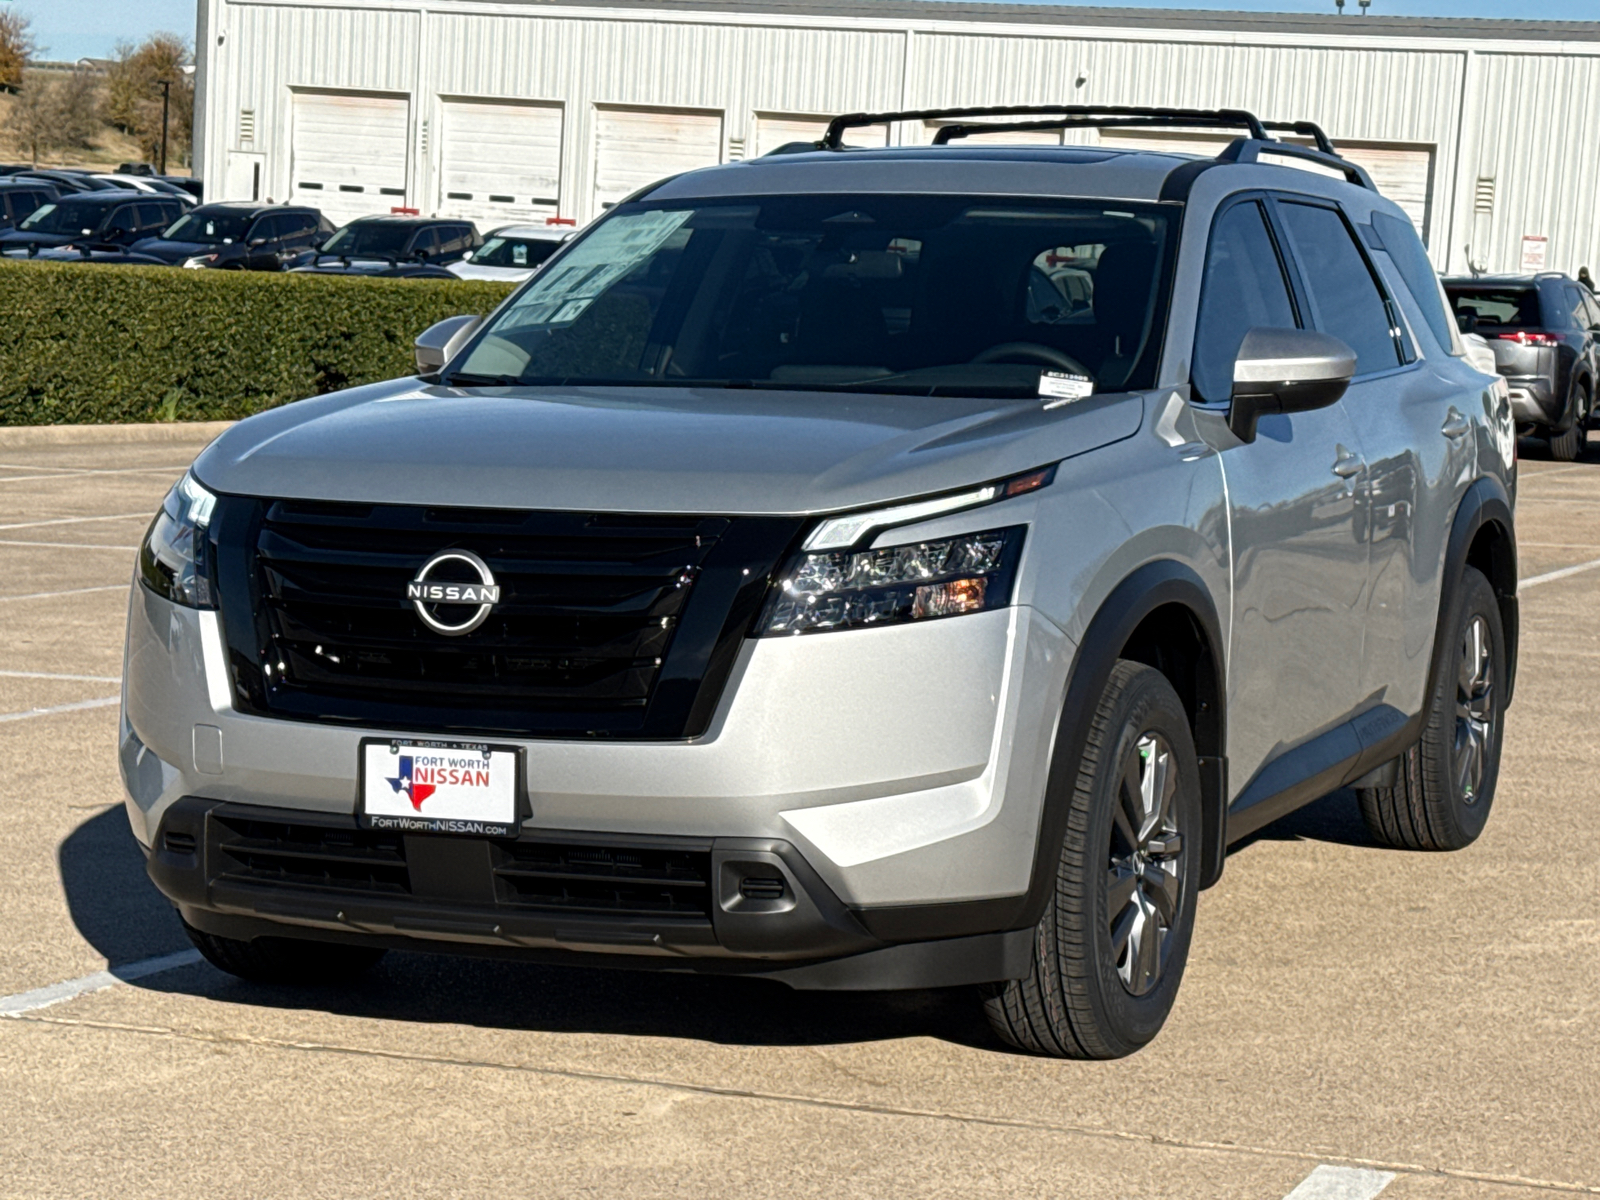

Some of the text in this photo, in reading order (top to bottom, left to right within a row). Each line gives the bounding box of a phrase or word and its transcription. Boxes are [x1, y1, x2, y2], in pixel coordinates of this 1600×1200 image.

[408, 584, 497, 601] NISSAN
[391, 739, 413, 747] FORT
[460, 743, 488, 751] TEXAS
[415, 756, 490, 770] FORT WORTH
[415, 767, 490, 788] NISSAN
